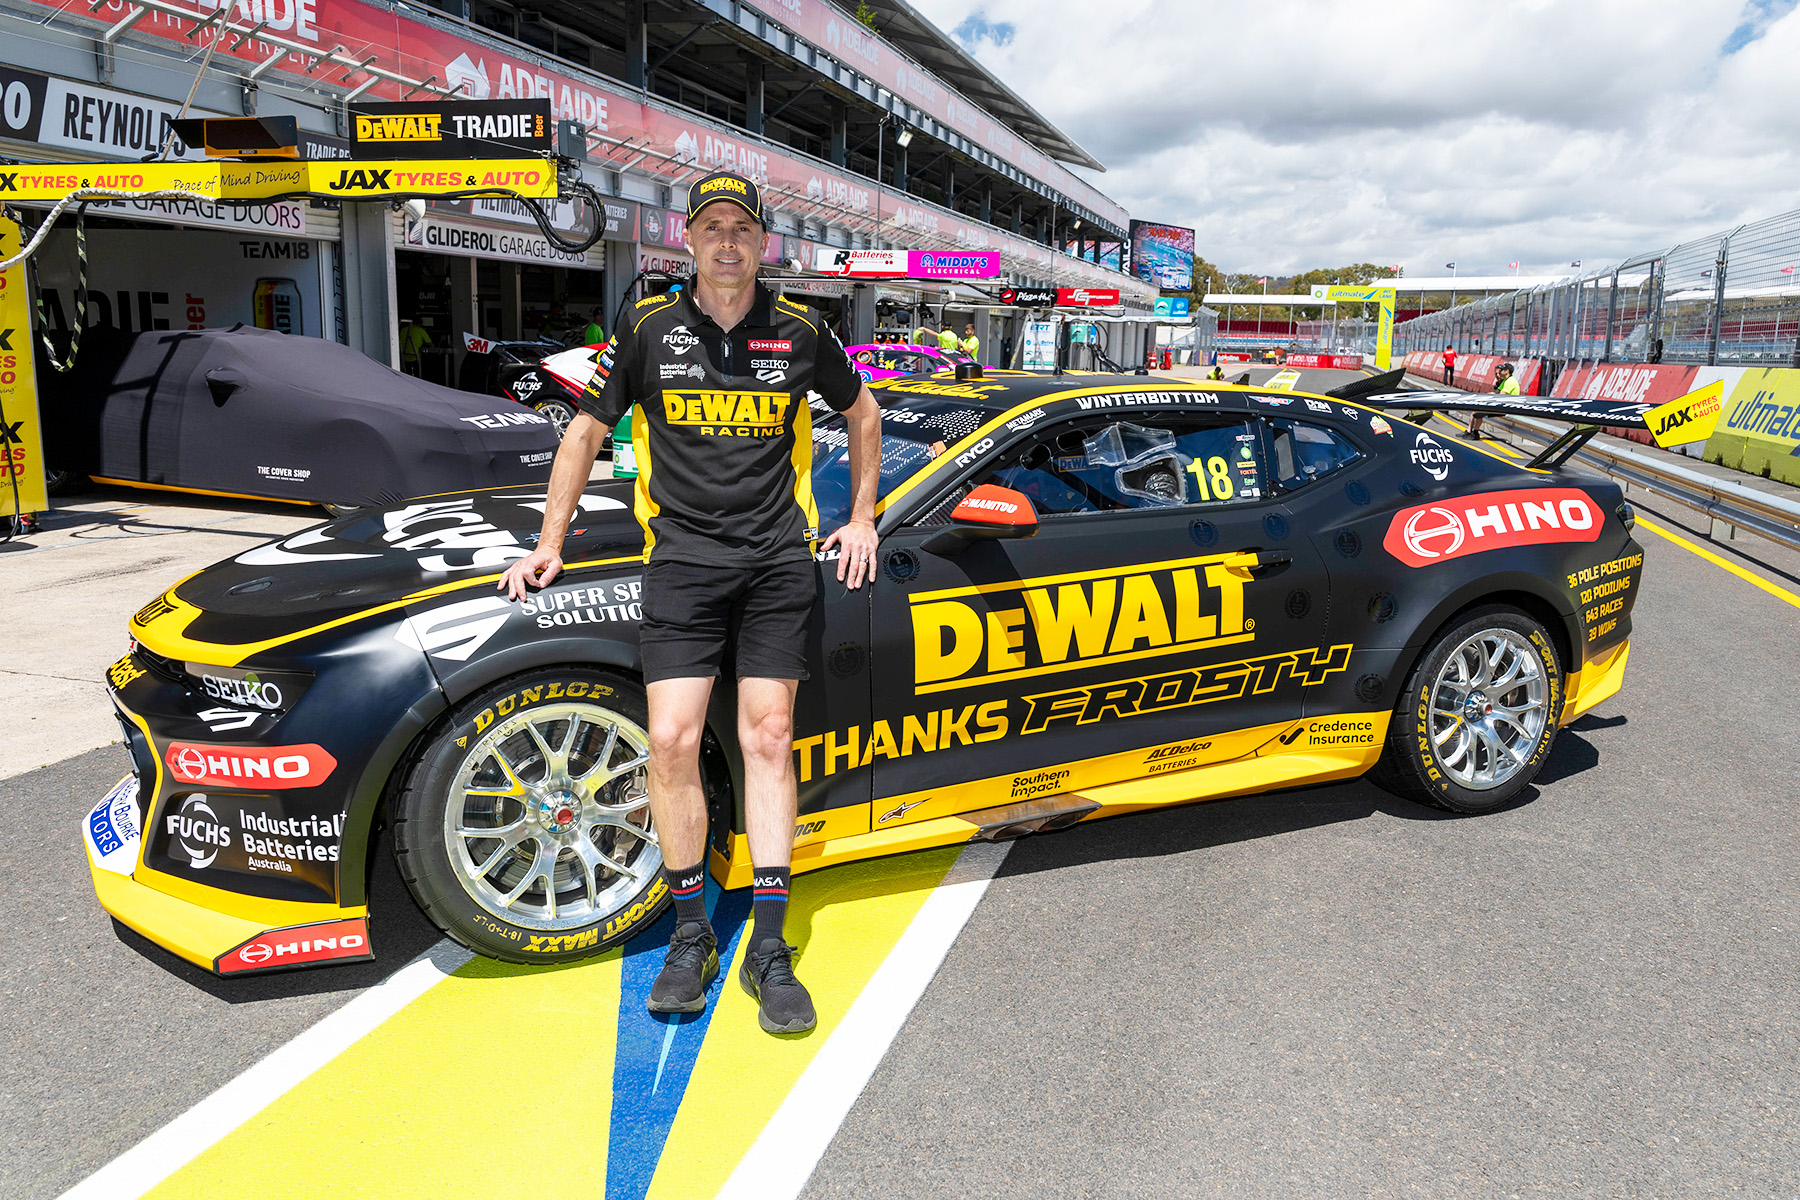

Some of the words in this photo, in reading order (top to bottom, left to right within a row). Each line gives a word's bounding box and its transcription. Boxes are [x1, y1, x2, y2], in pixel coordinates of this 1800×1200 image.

[842, 26, 879, 66] ADELAIDE
[0, 80, 31, 130] 0
[500, 62, 609, 133] ADELAIDE
[452, 114, 532, 138] TRADIE
[534, 114, 544, 138] Beer
[703, 135, 769, 184] ADELAIDE
[20, 175, 78, 189] TYRES
[81, 178, 90, 188] &
[94, 174, 144, 189] AUTO
[220, 172, 251, 188] Mind
[329, 169, 392, 190] JAX
[394, 172, 462, 186] TYRES
[465, 175, 477, 186] &
[481, 171, 540, 186] AUTO
[825, 178, 869, 212] ADELAIDE
[233, 203, 301, 229] DOORS
[425, 224, 497, 252] GLIDEROL
[499, 235, 547, 258] GARAGE
[669, 217, 683, 243] 14
[239, 241, 310, 259] TEAM18
[801, 244, 811, 265] 96
[851, 250, 894, 259] Batteries
[651, 257, 691, 276] GLIDEROL
[927, 267, 980, 275] ELECTRICAL
[936, 256, 988, 268] MIDDY'S
[1016, 291, 1037, 302] Pizza
[1331, 290, 1365, 298] ultimate
[662, 334, 700, 346] FUCHS
[1382, 316, 1390, 344] ultimate
[467, 338, 489, 353] 3M
[761, 342, 790, 350] HINO
[660, 362, 687, 370] Industrial
[750, 359, 790, 370] SEIKO
[884, 359, 896, 370] 14
[512, 380, 543, 392] FUCHS
[1600, 367, 1658, 403] ADELAIDE
[1075, 391, 1219, 409] WINTERBOTTOM
[1691, 395, 1718, 411] TYRES
[1005, 407, 1045, 431] METAMARK
[1503, 402, 1560, 413] TRUCK
[1561, 408, 1643, 422] WASHING
[1655, 406, 1691, 436] JAX
[1699, 403, 1720, 419] AUTO
[700, 426, 785, 438] RACING
[519, 455, 531, 464] THE
[954, 437, 995, 468] RYCO
[1410, 444, 1454, 465] FUCHS
[257, 465, 270, 475] THE
[271, 467, 292, 477] COVER
[293, 469, 311, 479] SHOP
[1186, 455, 1234, 501] 18
[970, 497, 1018, 514] MANITOU
[1465, 499, 1594, 538] HINO
[1566, 572, 1578, 589] 36
[1578, 565, 1600, 585] POLE
[520, 587, 607, 616] SUPER
[1579, 588, 1593, 605] 120
[1593, 576, 1631, 600] PODIUMS
[1585, 606, 1599, 624] 643
[1599, 596, 1624, 618] RACES
[1588, 626, 1598, 642] 39
[1598, 617, 1617, 637] WINS
[201, 673, 283, 709] SEIKO
[473, 682, 615, 736] DUNLOP
[793, 699, 1010, 783] THANKS
[1020, 642, 1353, 736] FROSTY
[1309, 720, 1373, 733] Credence
[1416, 685, 1443, 782] DUNLOP
[1146, 741, 1213, 760] ACDelco
[1308, 733, 1375, 746] Insurance
[207, 754, 311, 779] HINO
[1148, 757, 1197, 773] BATTERIES
[1012, 769, 1070, 788] Southern
[93, 800, 119, 854] OTORS
[114, 804, 140, 841] BOURKE
[166, 814, 232, 848] FUCHS
[239, 808, 342, 838] Industrial
[242, 833, 341, 863] Batteries
[248, 856, 293, 873] Australia
[754, 877, 784, 887] NASA
[603, 877, 670, 941] SPORT
[276, 934, 364, 957] HINO
[522, 927, 599, 953] MAXX
